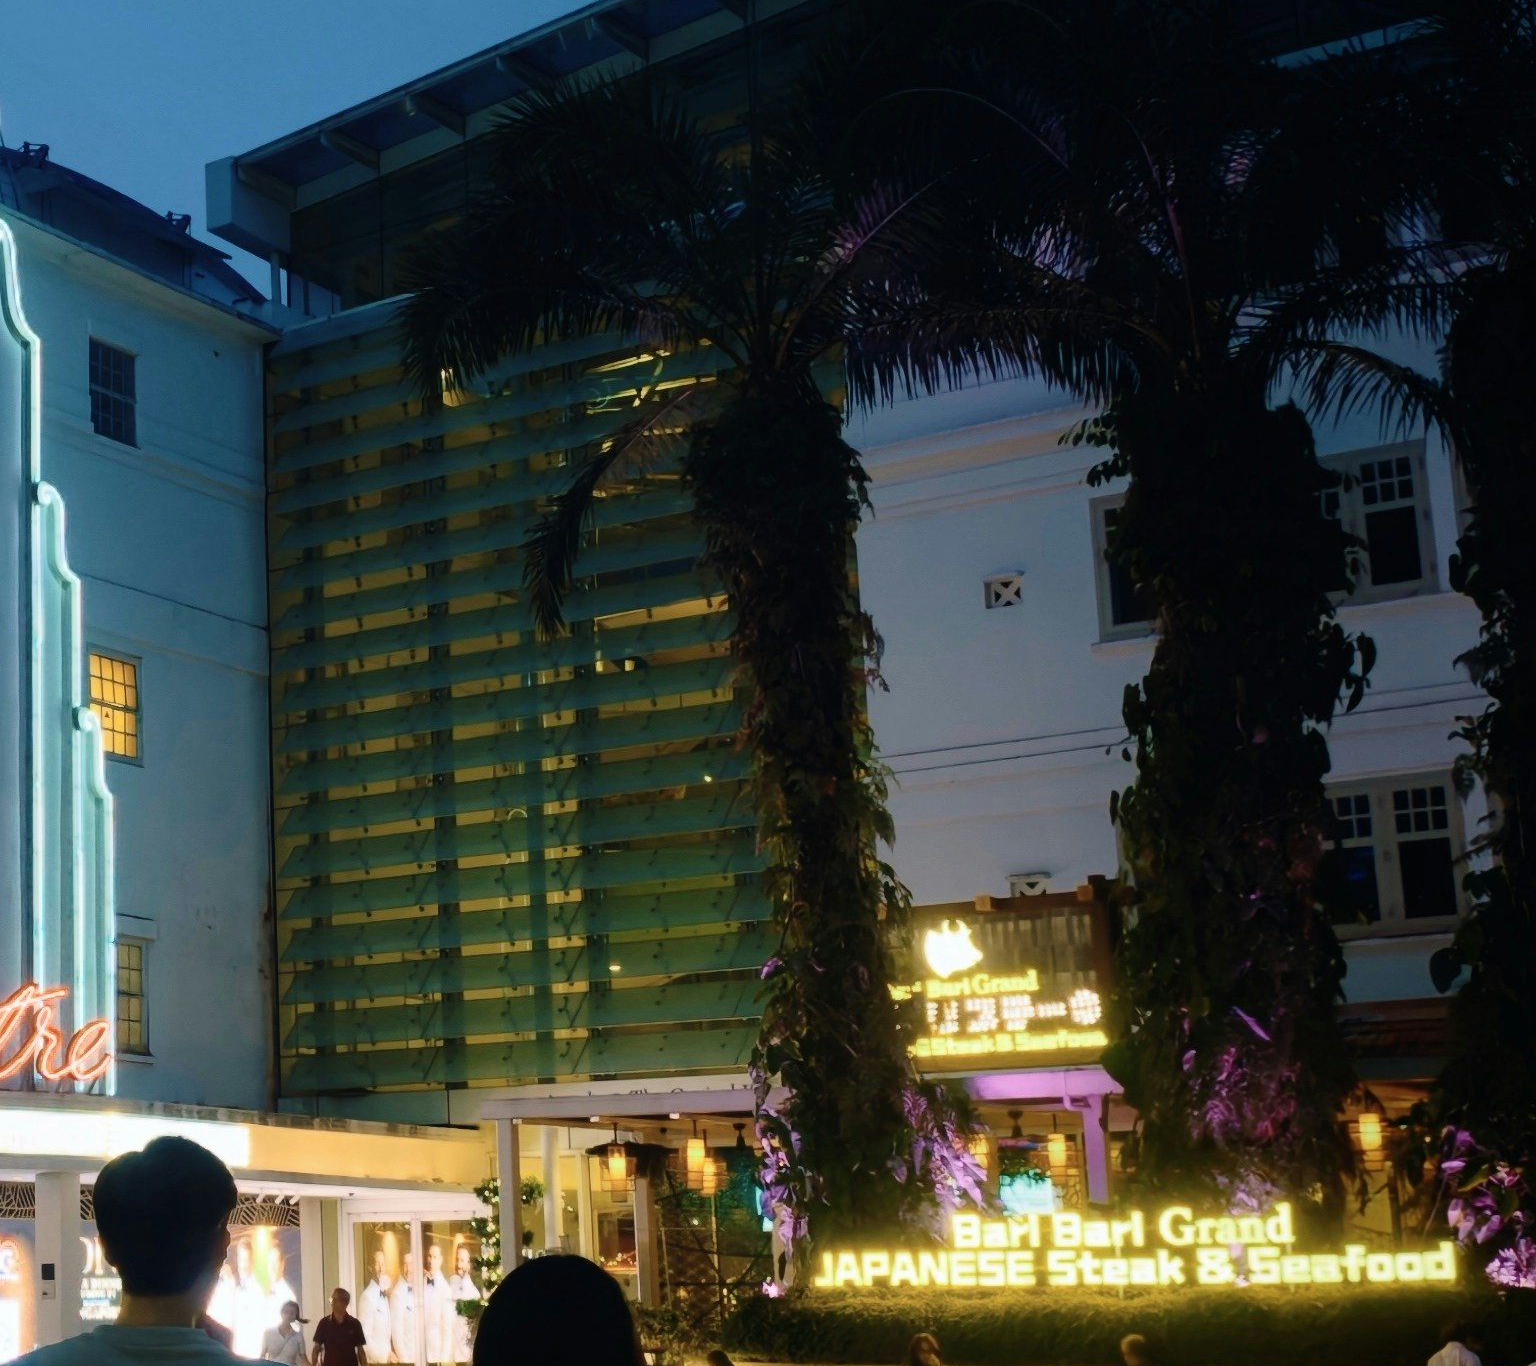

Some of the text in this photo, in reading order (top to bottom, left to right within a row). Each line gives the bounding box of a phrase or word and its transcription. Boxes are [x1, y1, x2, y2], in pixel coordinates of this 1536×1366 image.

[971, 969, 1039, 994] Grand
[1158, 1201, 1296, 1245] Grand
[814, 1241, 1457, 1287] JAPANESE Steak & Seafood
